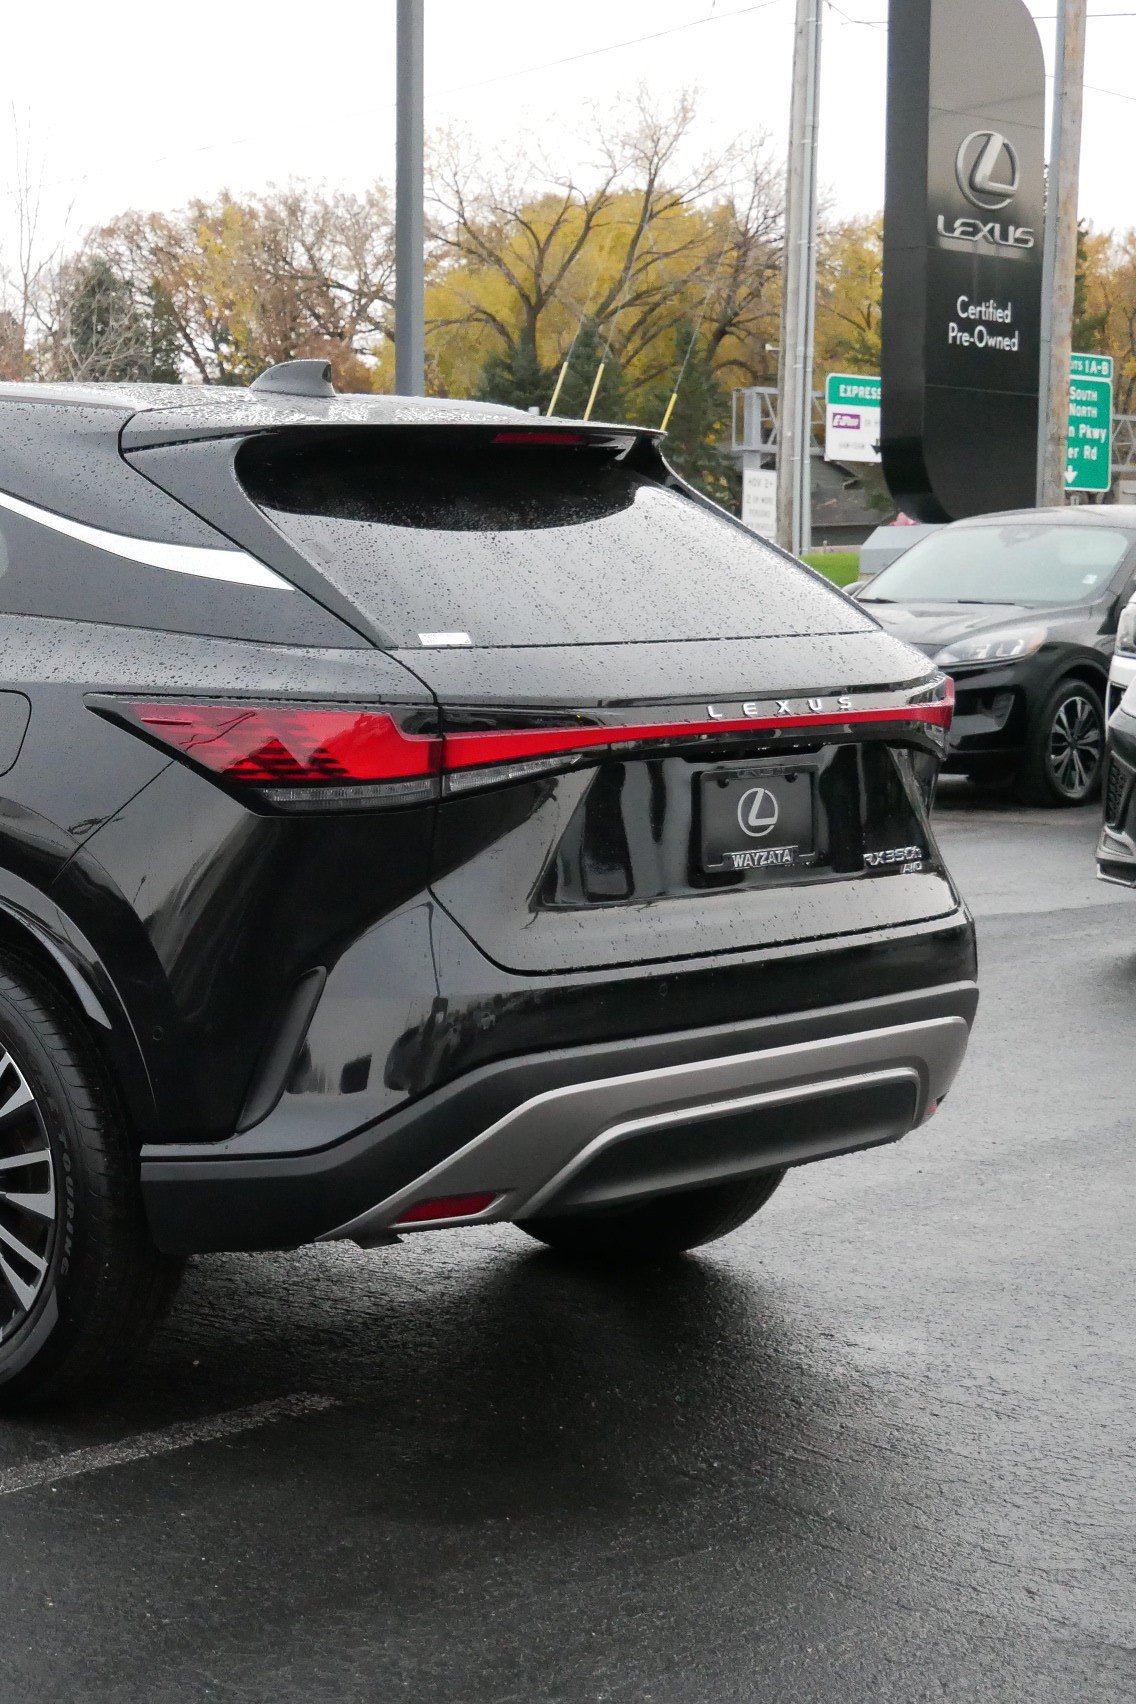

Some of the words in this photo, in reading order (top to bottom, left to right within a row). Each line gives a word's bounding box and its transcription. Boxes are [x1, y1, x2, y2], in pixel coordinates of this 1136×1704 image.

[937, 214, 1034, 248] LEXUS
[957, 295, 1012, 323] Certified
[948, 322, 1019, 351] Pre-Owned
[1079, 424, 1107, 443] Pkwy
[1083, 445, 1098, 460] Rd
[707, 697, 853, 718] LEXUS
[731, 848, 792, 870] WAYZATA
